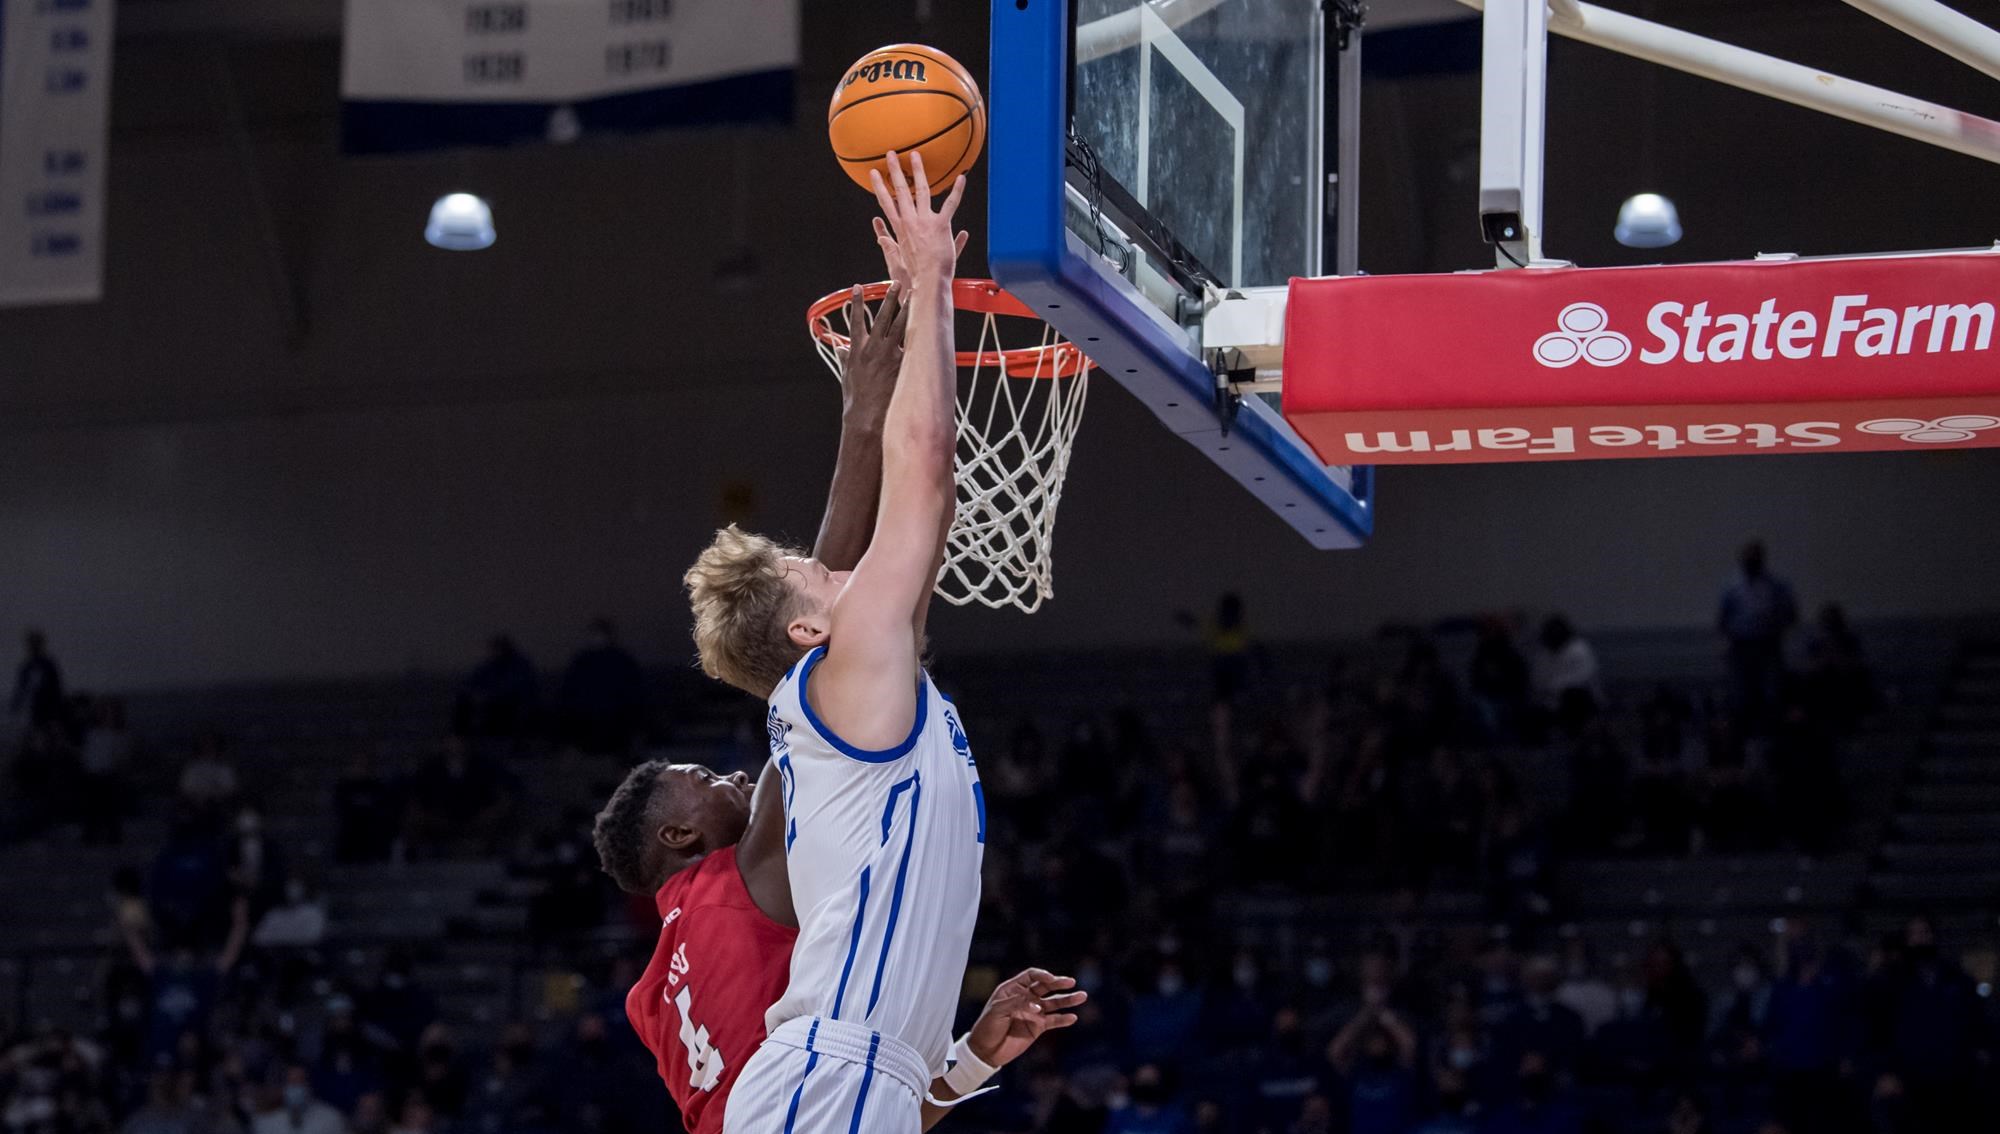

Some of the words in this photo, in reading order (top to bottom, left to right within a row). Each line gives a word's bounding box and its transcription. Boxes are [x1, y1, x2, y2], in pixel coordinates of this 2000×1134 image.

[842, 59, 928, 90] Wilso
[1344, 426, 1576, 455] Farm
[1589, 422, 1841, 450] State
[674, 984, 726, 1093] 4
